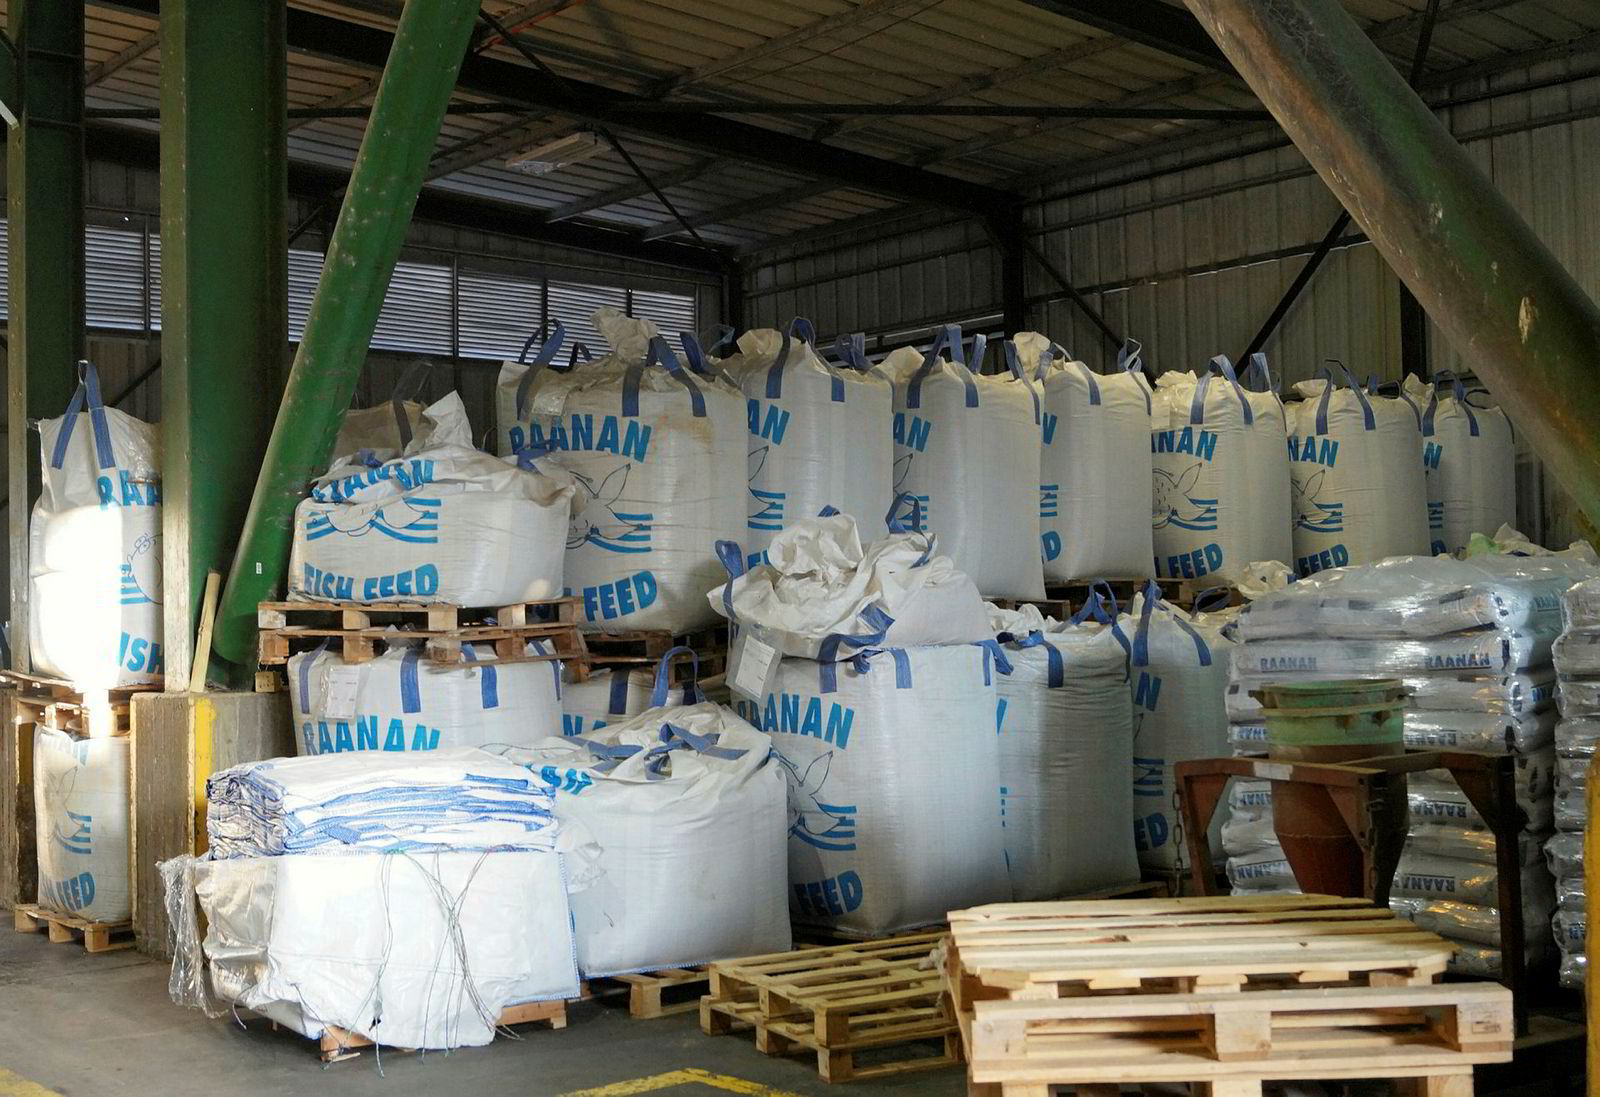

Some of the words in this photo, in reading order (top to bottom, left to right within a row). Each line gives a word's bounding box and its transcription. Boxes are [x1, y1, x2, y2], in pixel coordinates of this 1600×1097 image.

[1167, 544, 1223, 579] FEED
[583, 571, 657, 622] FEED
[1260, 657, 1318, 671] RAANAN
[302, 714, 441, 757] RAANAN
